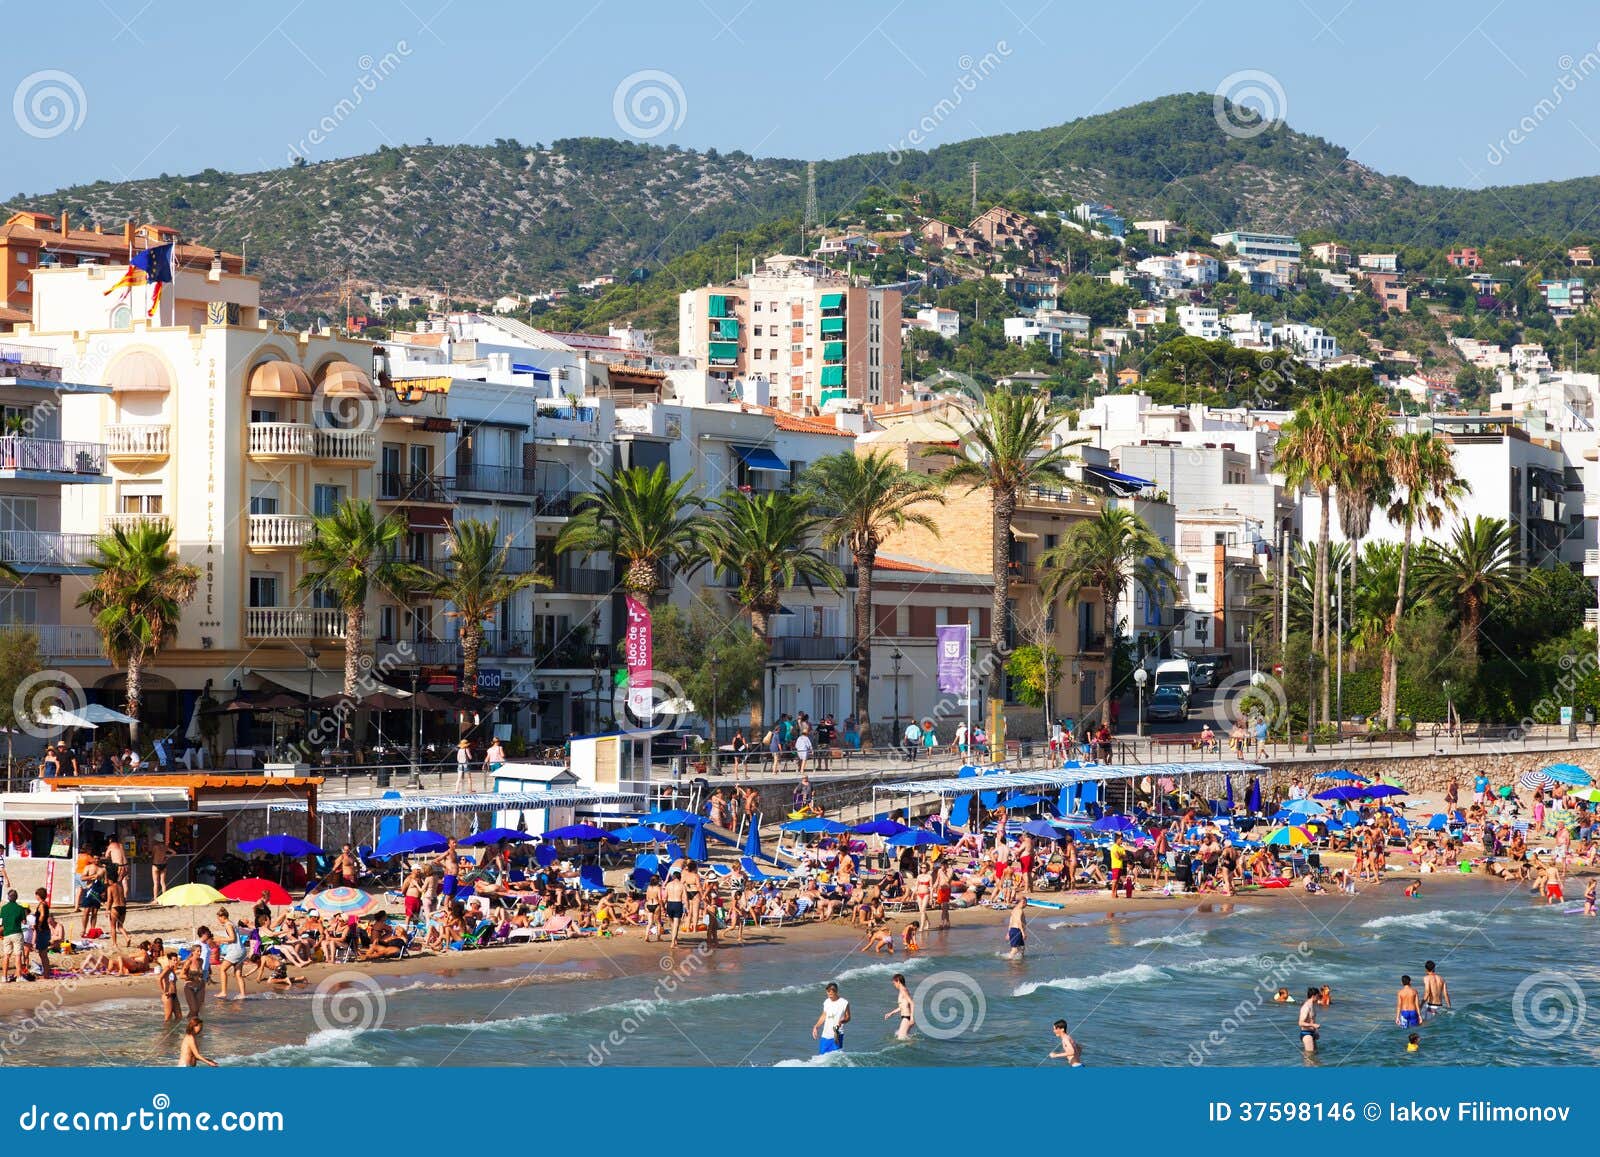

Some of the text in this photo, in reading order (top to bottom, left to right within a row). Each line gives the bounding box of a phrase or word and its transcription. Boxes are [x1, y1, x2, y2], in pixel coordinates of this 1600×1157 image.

[206, 501, 215, 554] PLAYA
[206, 562, 214, 615] HOTEL
[628, 626, 638, 666] Lloc de
[637, 626, 647, 666] Socors
